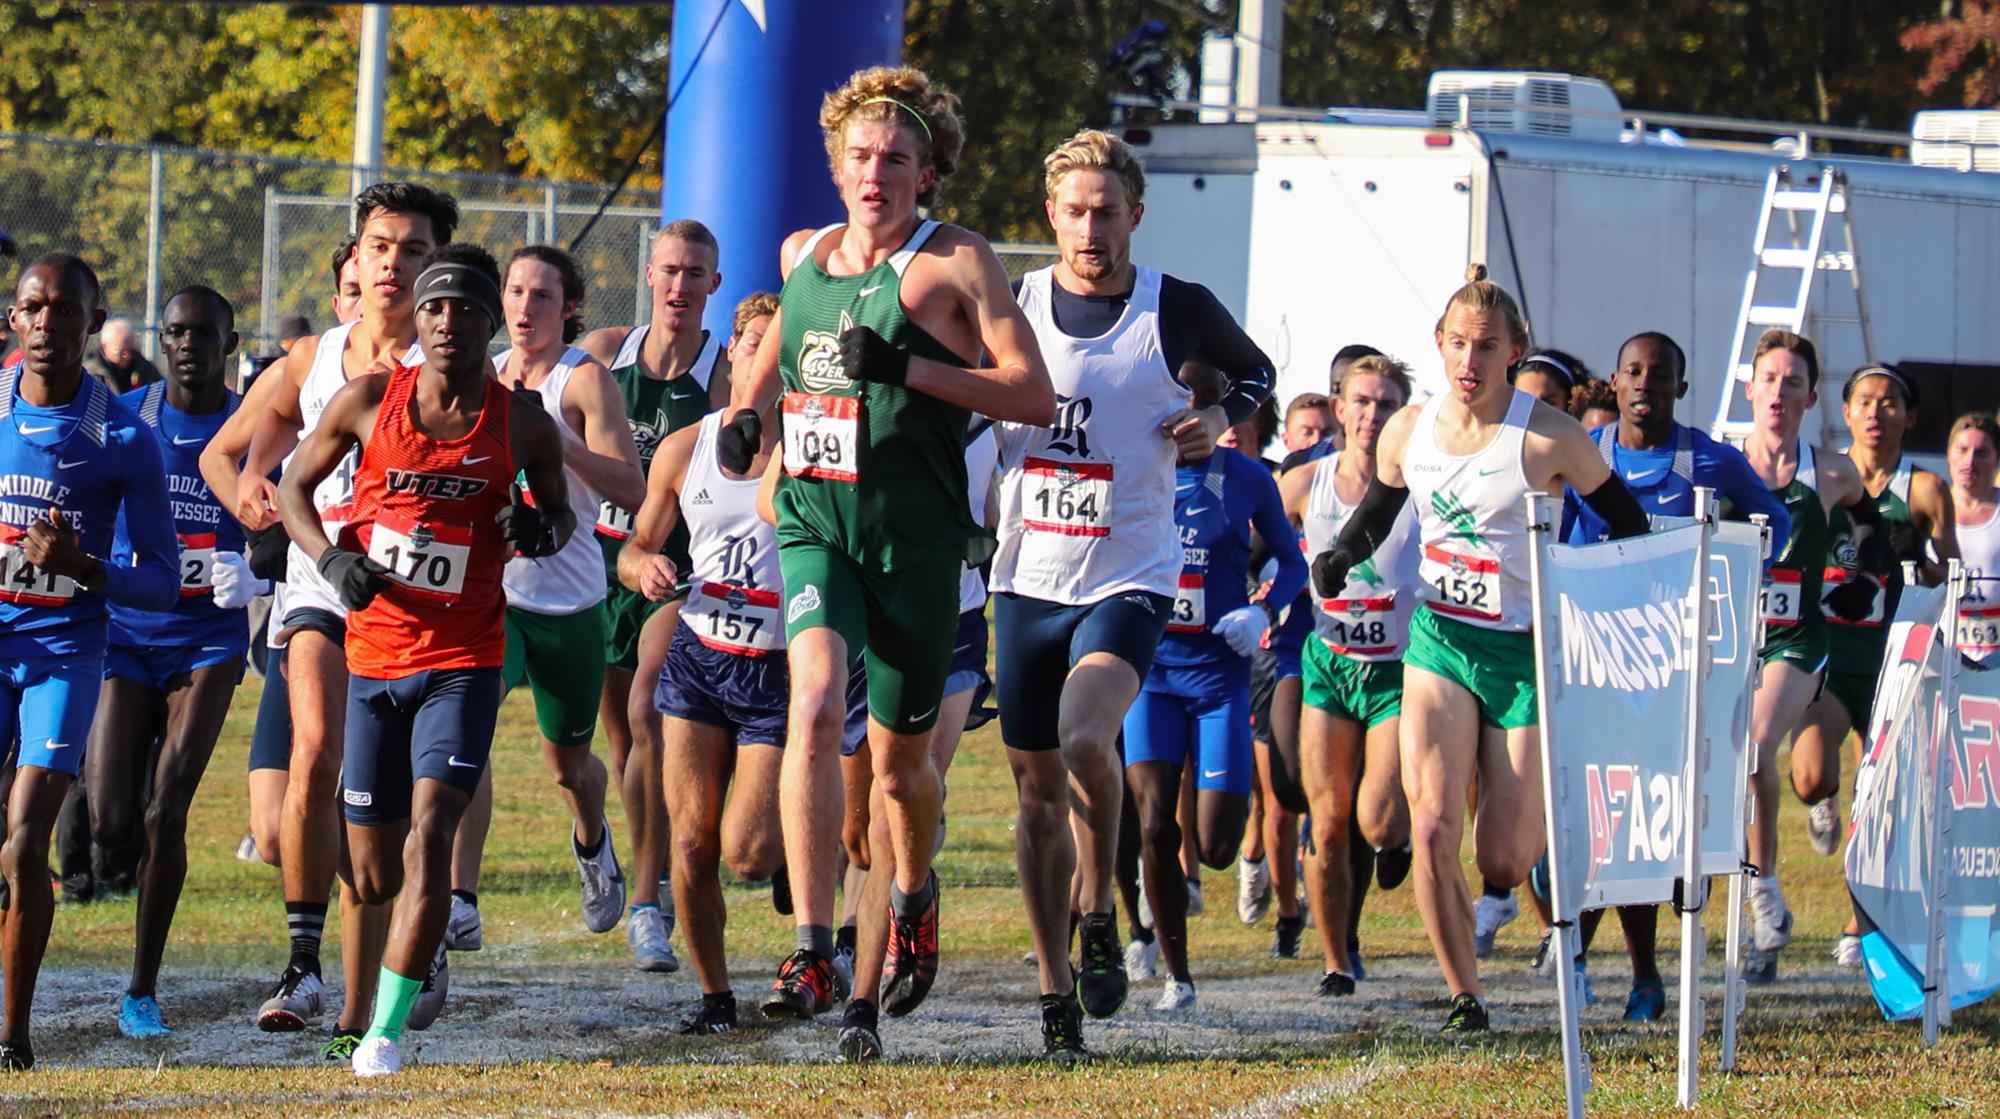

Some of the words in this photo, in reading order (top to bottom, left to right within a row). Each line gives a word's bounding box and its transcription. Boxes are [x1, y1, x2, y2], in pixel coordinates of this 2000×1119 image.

[1047, 393, 1091, 458] R
[795, 429, 842, 465] 109
[0, 474, 70, 506] MIDDLE
[165, 474, 209, 501] DDLE
[385, 468, 489, 500] UTEP
[1034, 488, 1098, 522] 164
[384, 545, 451, 587] 170
[718, 534, 758, 589] R
[1435, 576, 1488, 608] 152
[708, 609, 764, 644] 157
[1334, 621, 1386, 645] 148
